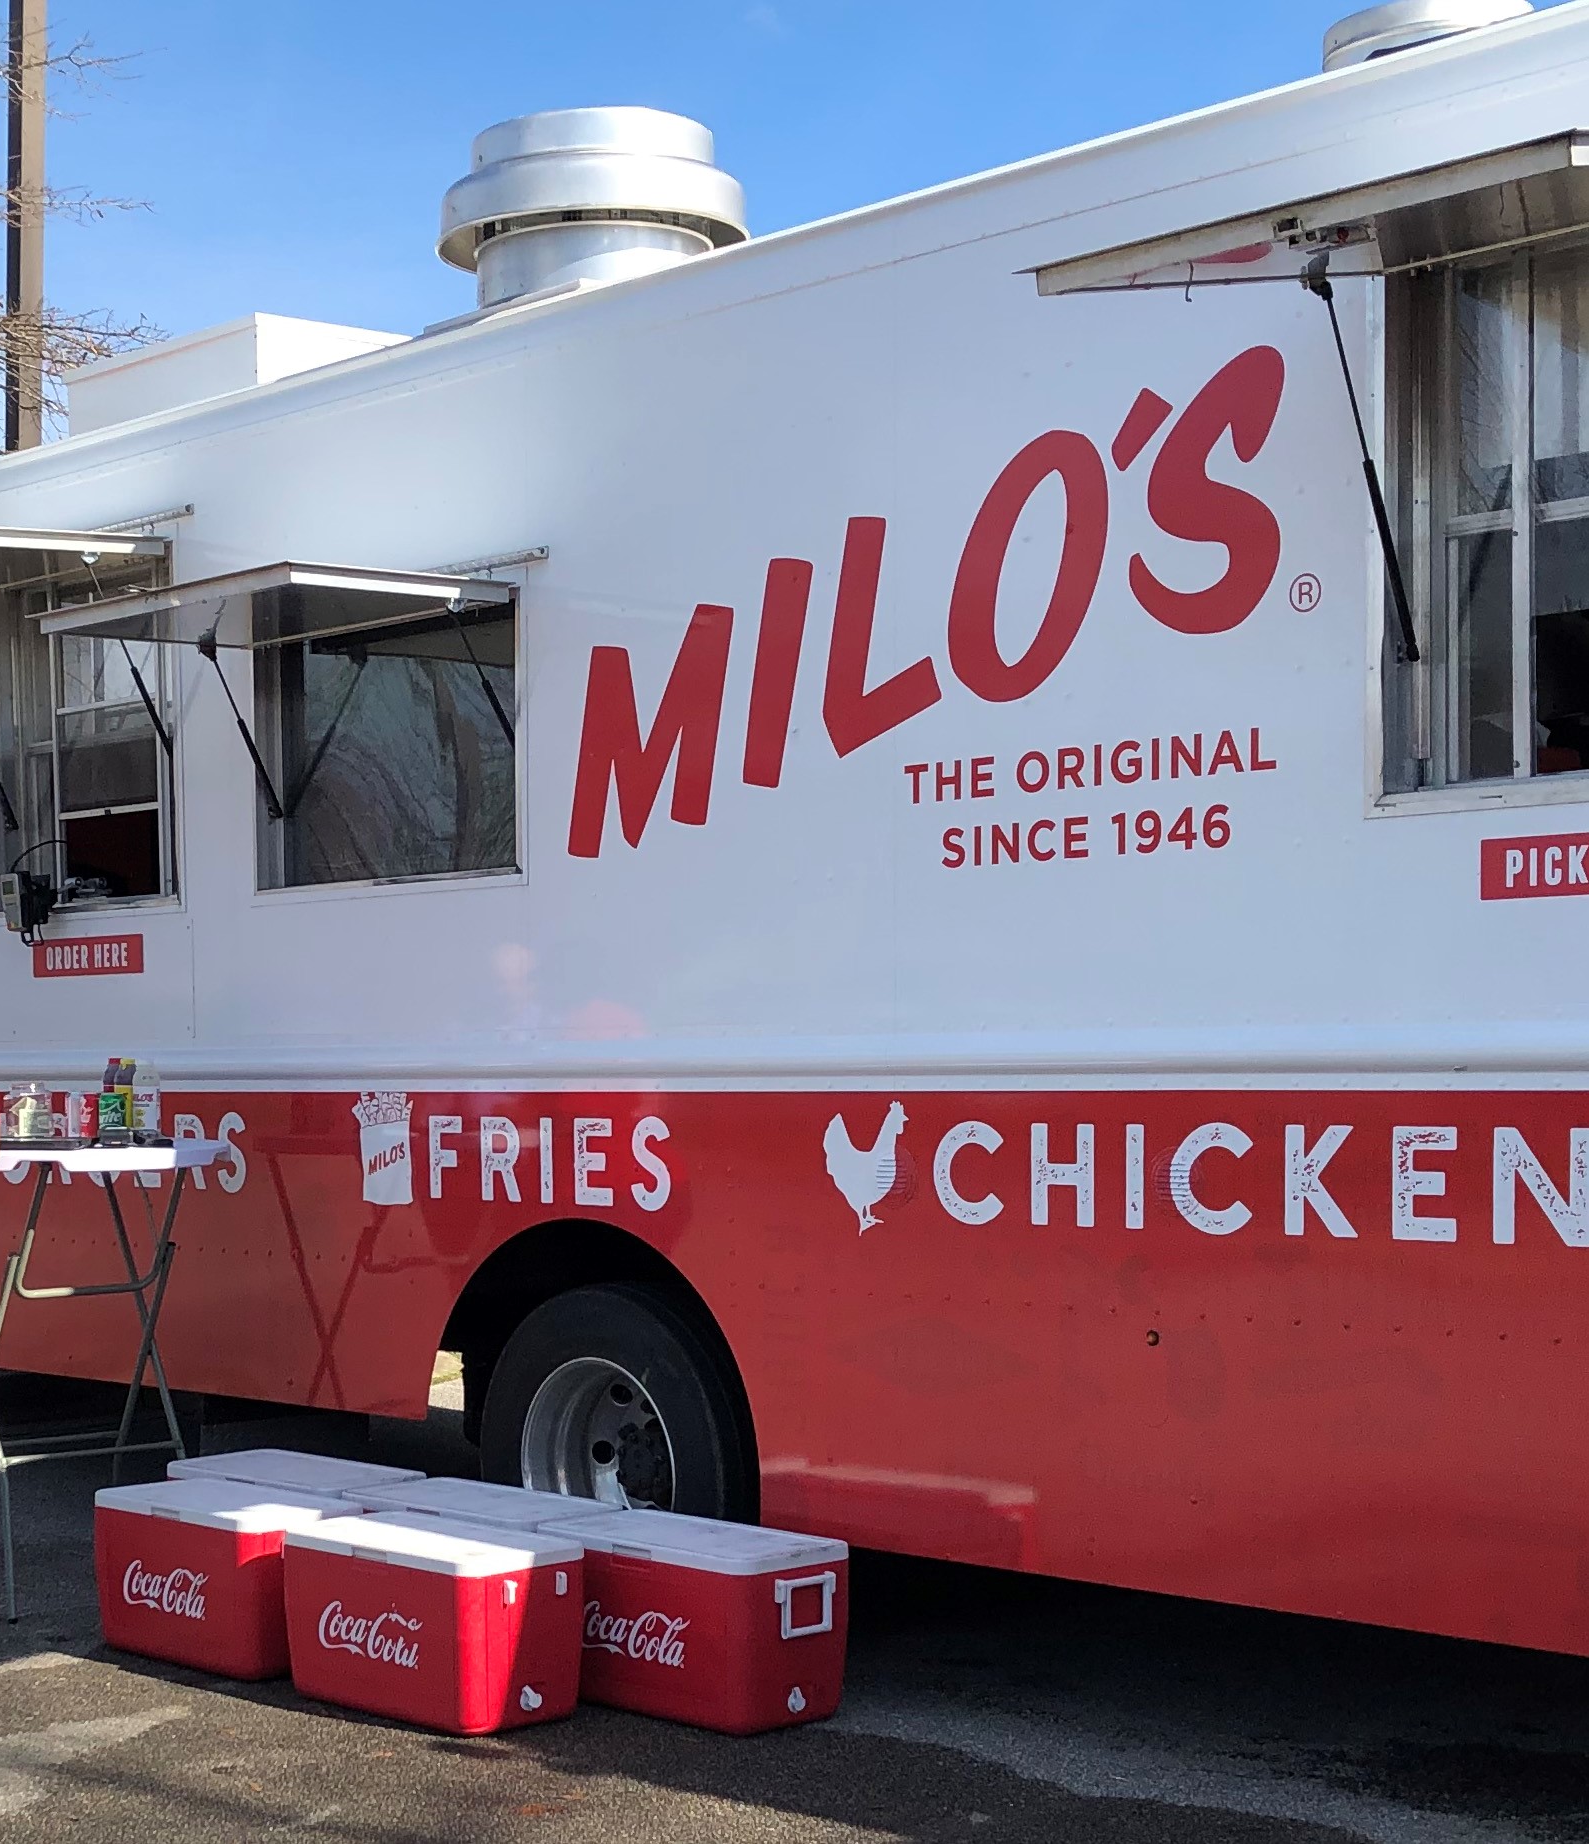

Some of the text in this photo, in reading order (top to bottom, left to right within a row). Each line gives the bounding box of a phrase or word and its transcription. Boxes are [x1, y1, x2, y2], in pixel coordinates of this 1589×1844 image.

[567, 345, 1285, 859] MILO'S
[904, 727, 1277, 804] THE ORIGINAL
[941, 804, 1230, 869] SINCE 1946
[1506, 844, 1589, 888] PICK
[46, 943, 128, 970] ORDER HERE
[368, 1141, 406, 1176] MILO'S
[429, 1115, 671, 1212] FRIES
[932, 1120, 1589, 1248] CHICKEN
[123, 1559, 210, 1621] Coca-Cola
